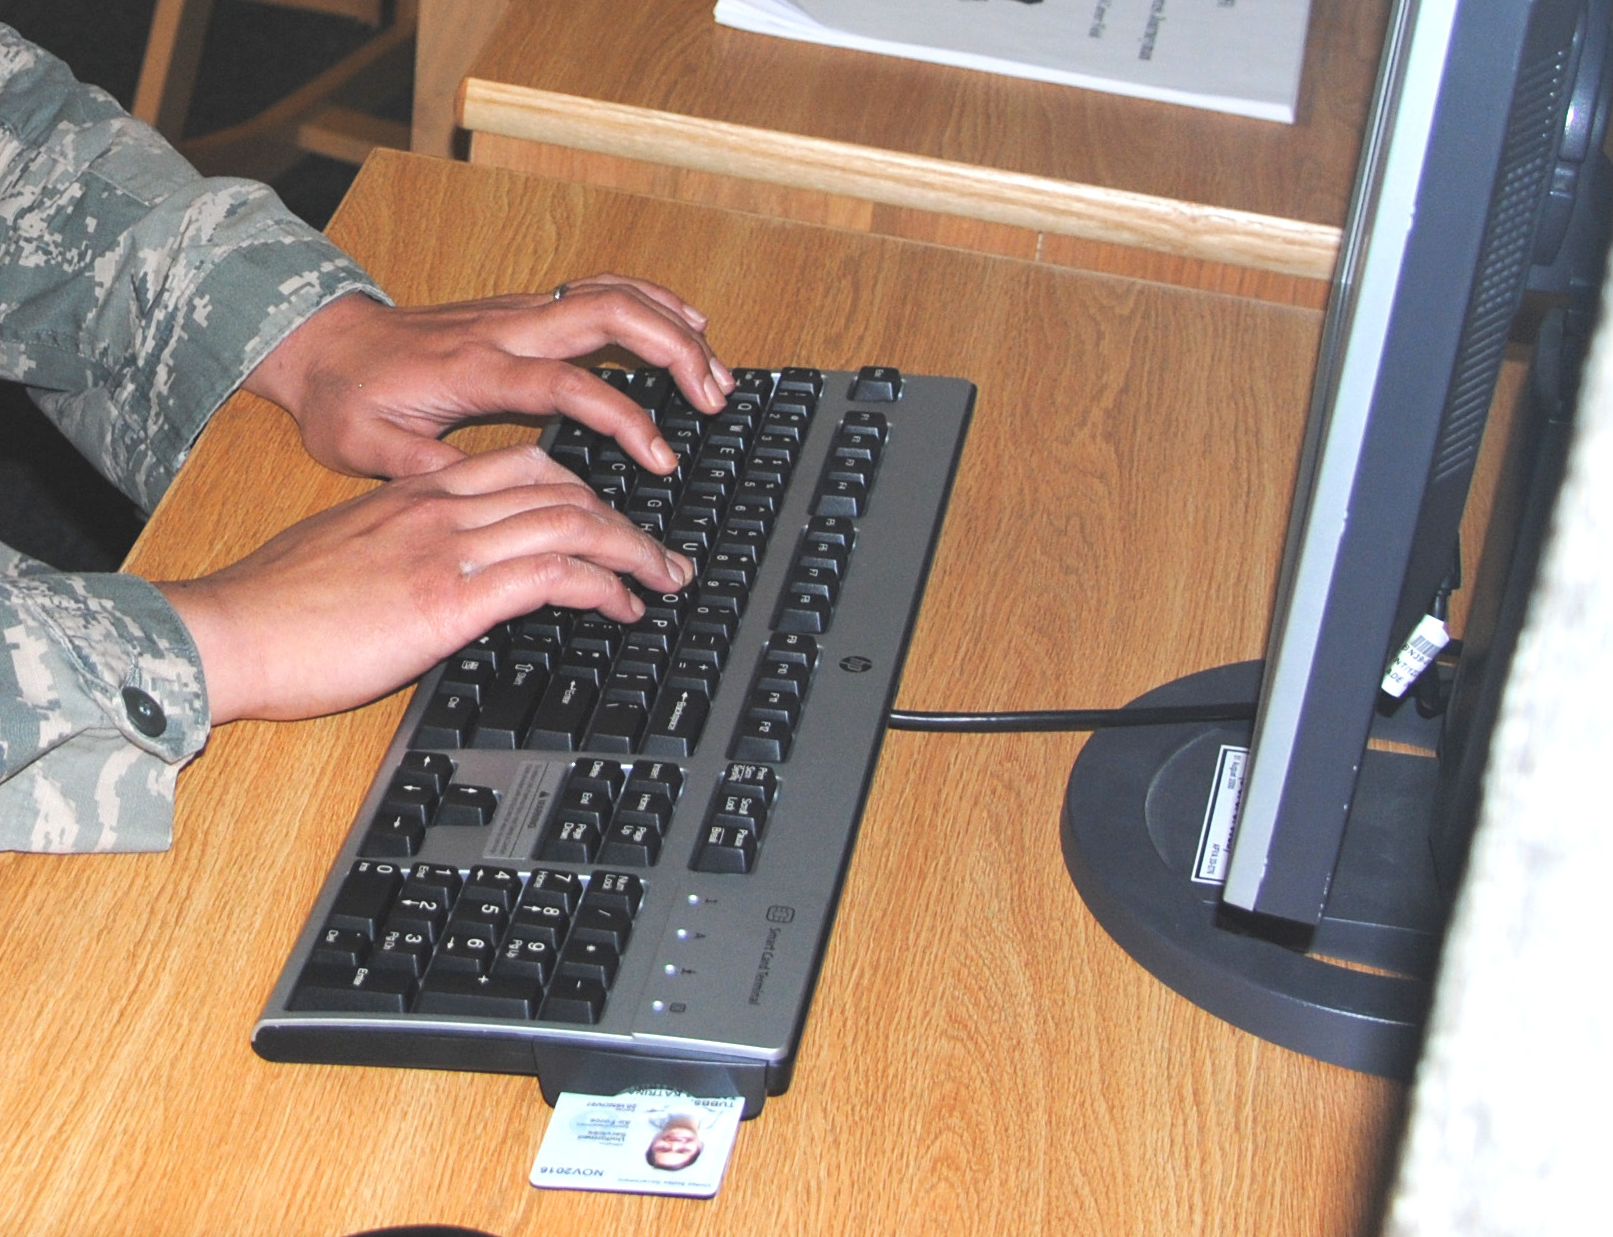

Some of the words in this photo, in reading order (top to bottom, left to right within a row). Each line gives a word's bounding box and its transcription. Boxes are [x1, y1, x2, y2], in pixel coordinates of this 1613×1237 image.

[419, 900, 437, 911] 2
[481, 904, 499, 914] 5
[542, 906, 560, 916] 8
[405, 933, 422, 944] 3
[467, 938, 485, 949] 6
[764, 926, 782, 951] Smart
[528, 941, 545, 952] 9
[758, 951, 774, 970] Card
[748, 970, 769, 1006] Terminal
